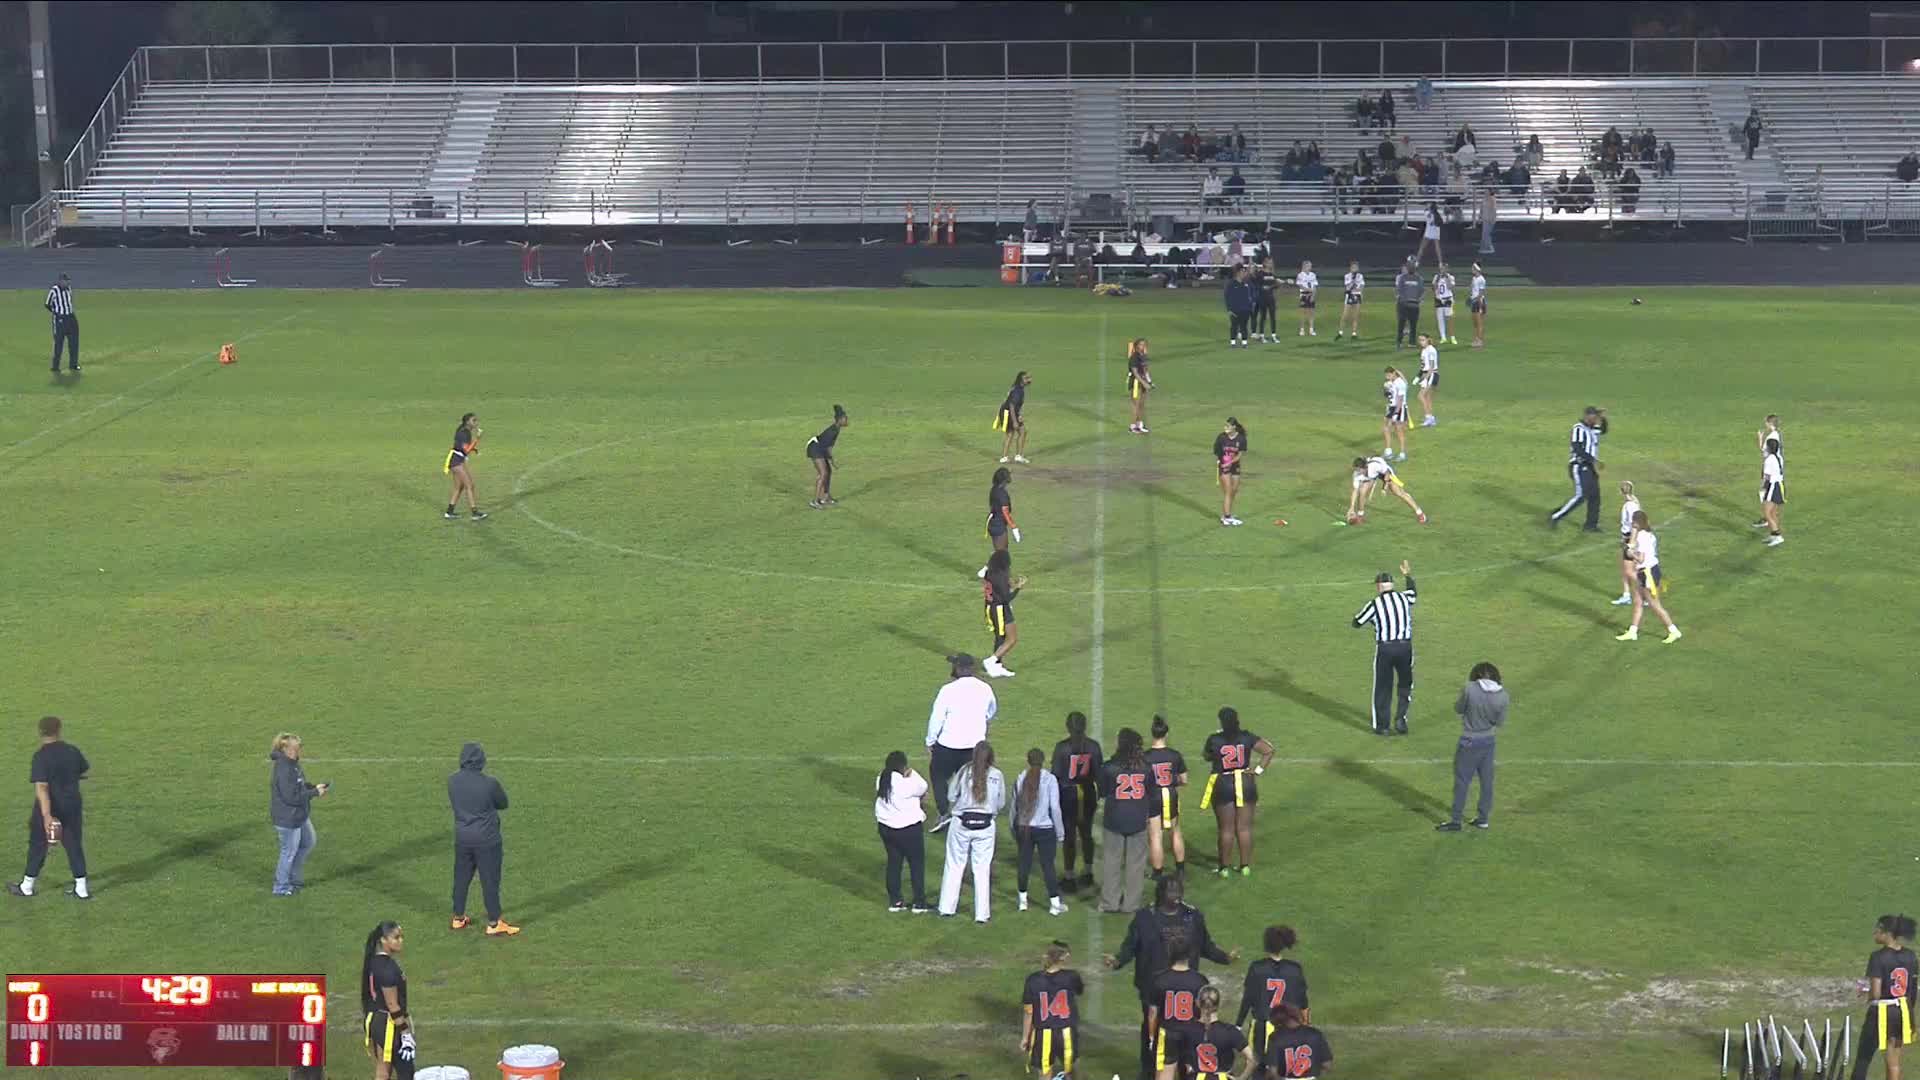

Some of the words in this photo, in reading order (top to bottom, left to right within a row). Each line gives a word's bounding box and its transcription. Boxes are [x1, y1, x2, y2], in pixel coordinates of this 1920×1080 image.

[1069, 753, 1092, 779] 17
[1219, 743, 1245, 769] 21
[1115, 774, 1146, 800] 25
[1265, 977, 1287, 1008] 7
[1890, 967, 1909, 997] 3
[1038, 989, 1071, 1022] 14
[1163, 990, 1194, 1022] 18
[1284, 1044, 1313, 1077] 16
